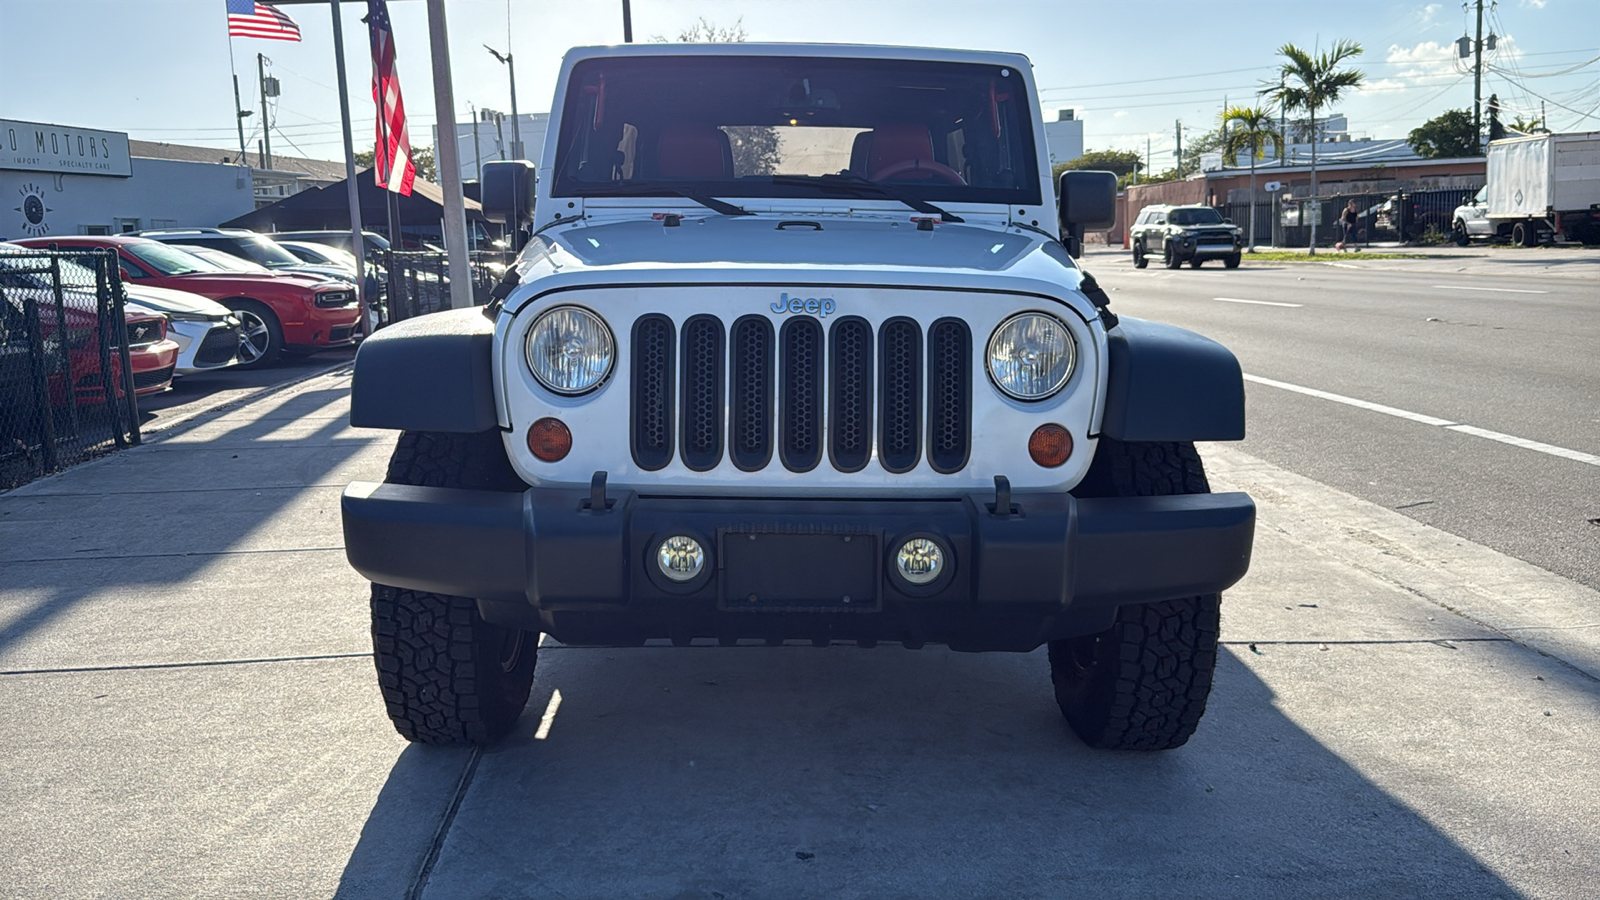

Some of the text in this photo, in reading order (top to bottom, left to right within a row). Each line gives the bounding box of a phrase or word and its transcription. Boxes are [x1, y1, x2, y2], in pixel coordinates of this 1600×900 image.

[0, 128, 109, 159] O MOTORS
[13, 157, 40, 165] IMPORT
[59, 160, 93, 168] SPECIALTY
[770, 292, 836, 318] Jeep
